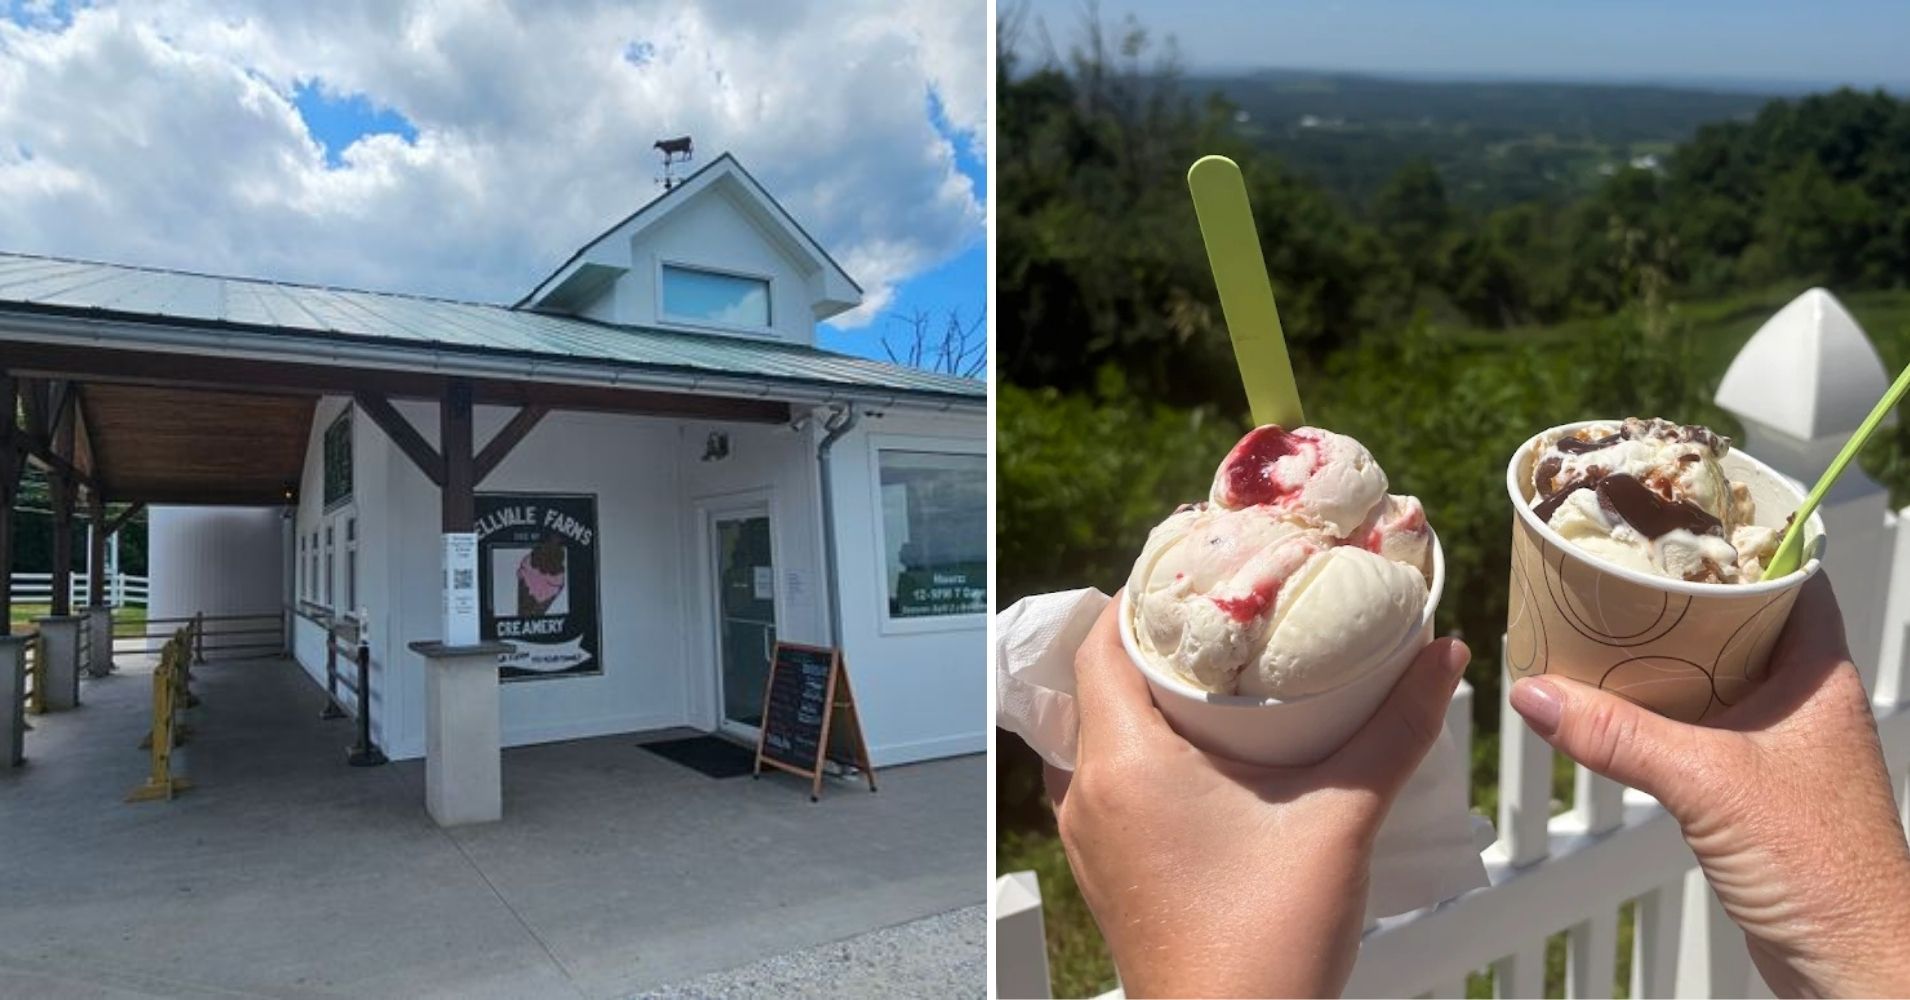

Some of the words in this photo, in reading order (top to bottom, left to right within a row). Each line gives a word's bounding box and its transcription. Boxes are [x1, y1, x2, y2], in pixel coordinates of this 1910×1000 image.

[474, 506, 536, 540] ELLVALE
[544, 509, 593, 546] FARMS
[496, 619, 565, 637] CREAMERY
